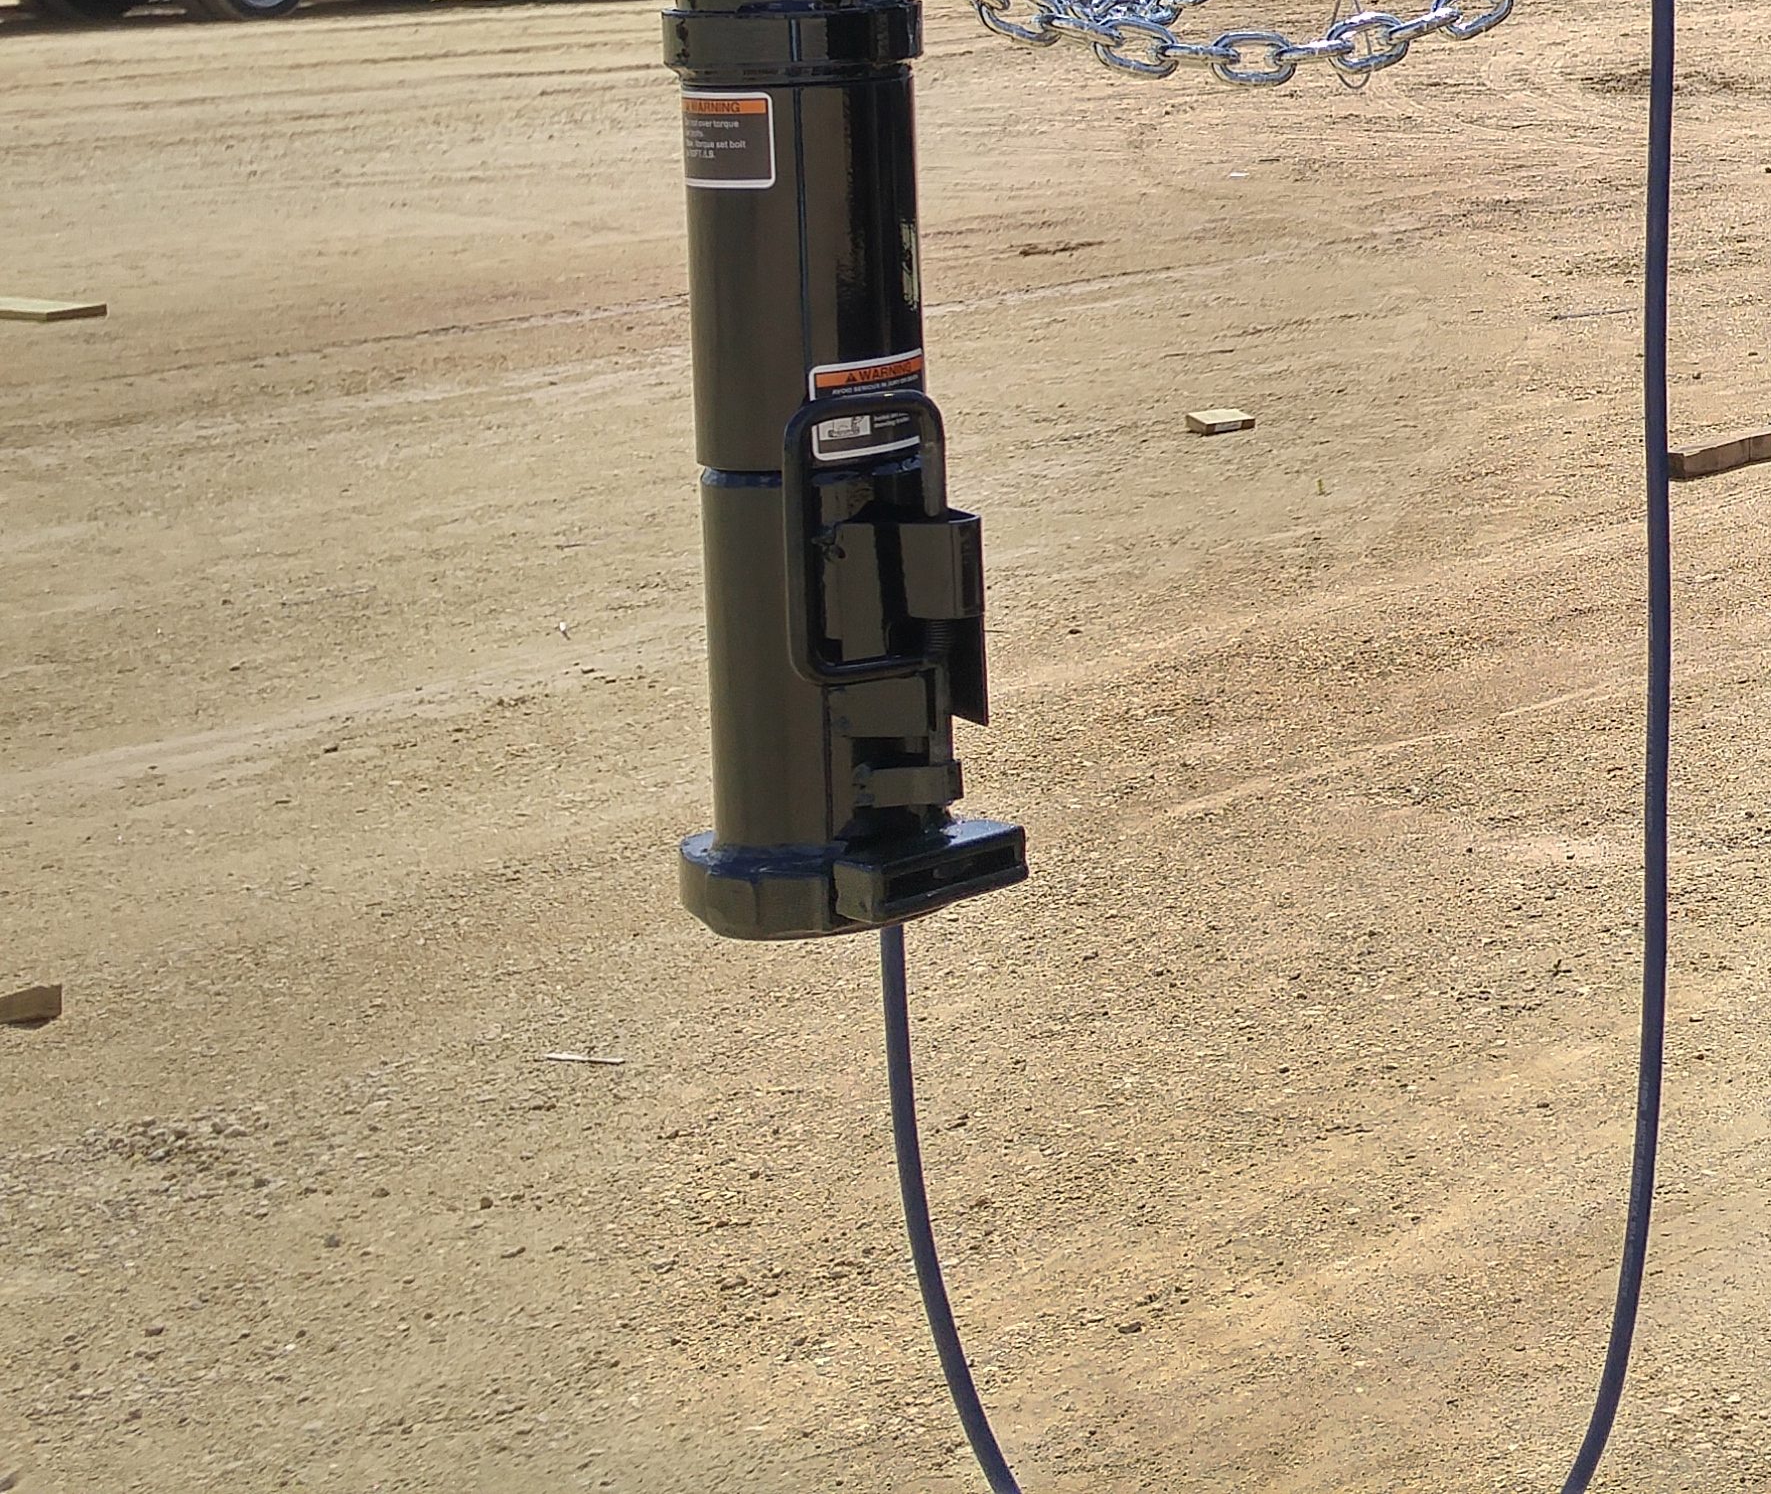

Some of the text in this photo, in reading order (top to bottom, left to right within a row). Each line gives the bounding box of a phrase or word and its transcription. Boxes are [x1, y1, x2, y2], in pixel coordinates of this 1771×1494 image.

[713, 120, 740, 130] torque
[716, 140, 729, 148] set
[729, 140, 746, 149] bolt
[858, 362, 912, 381] WARNING
